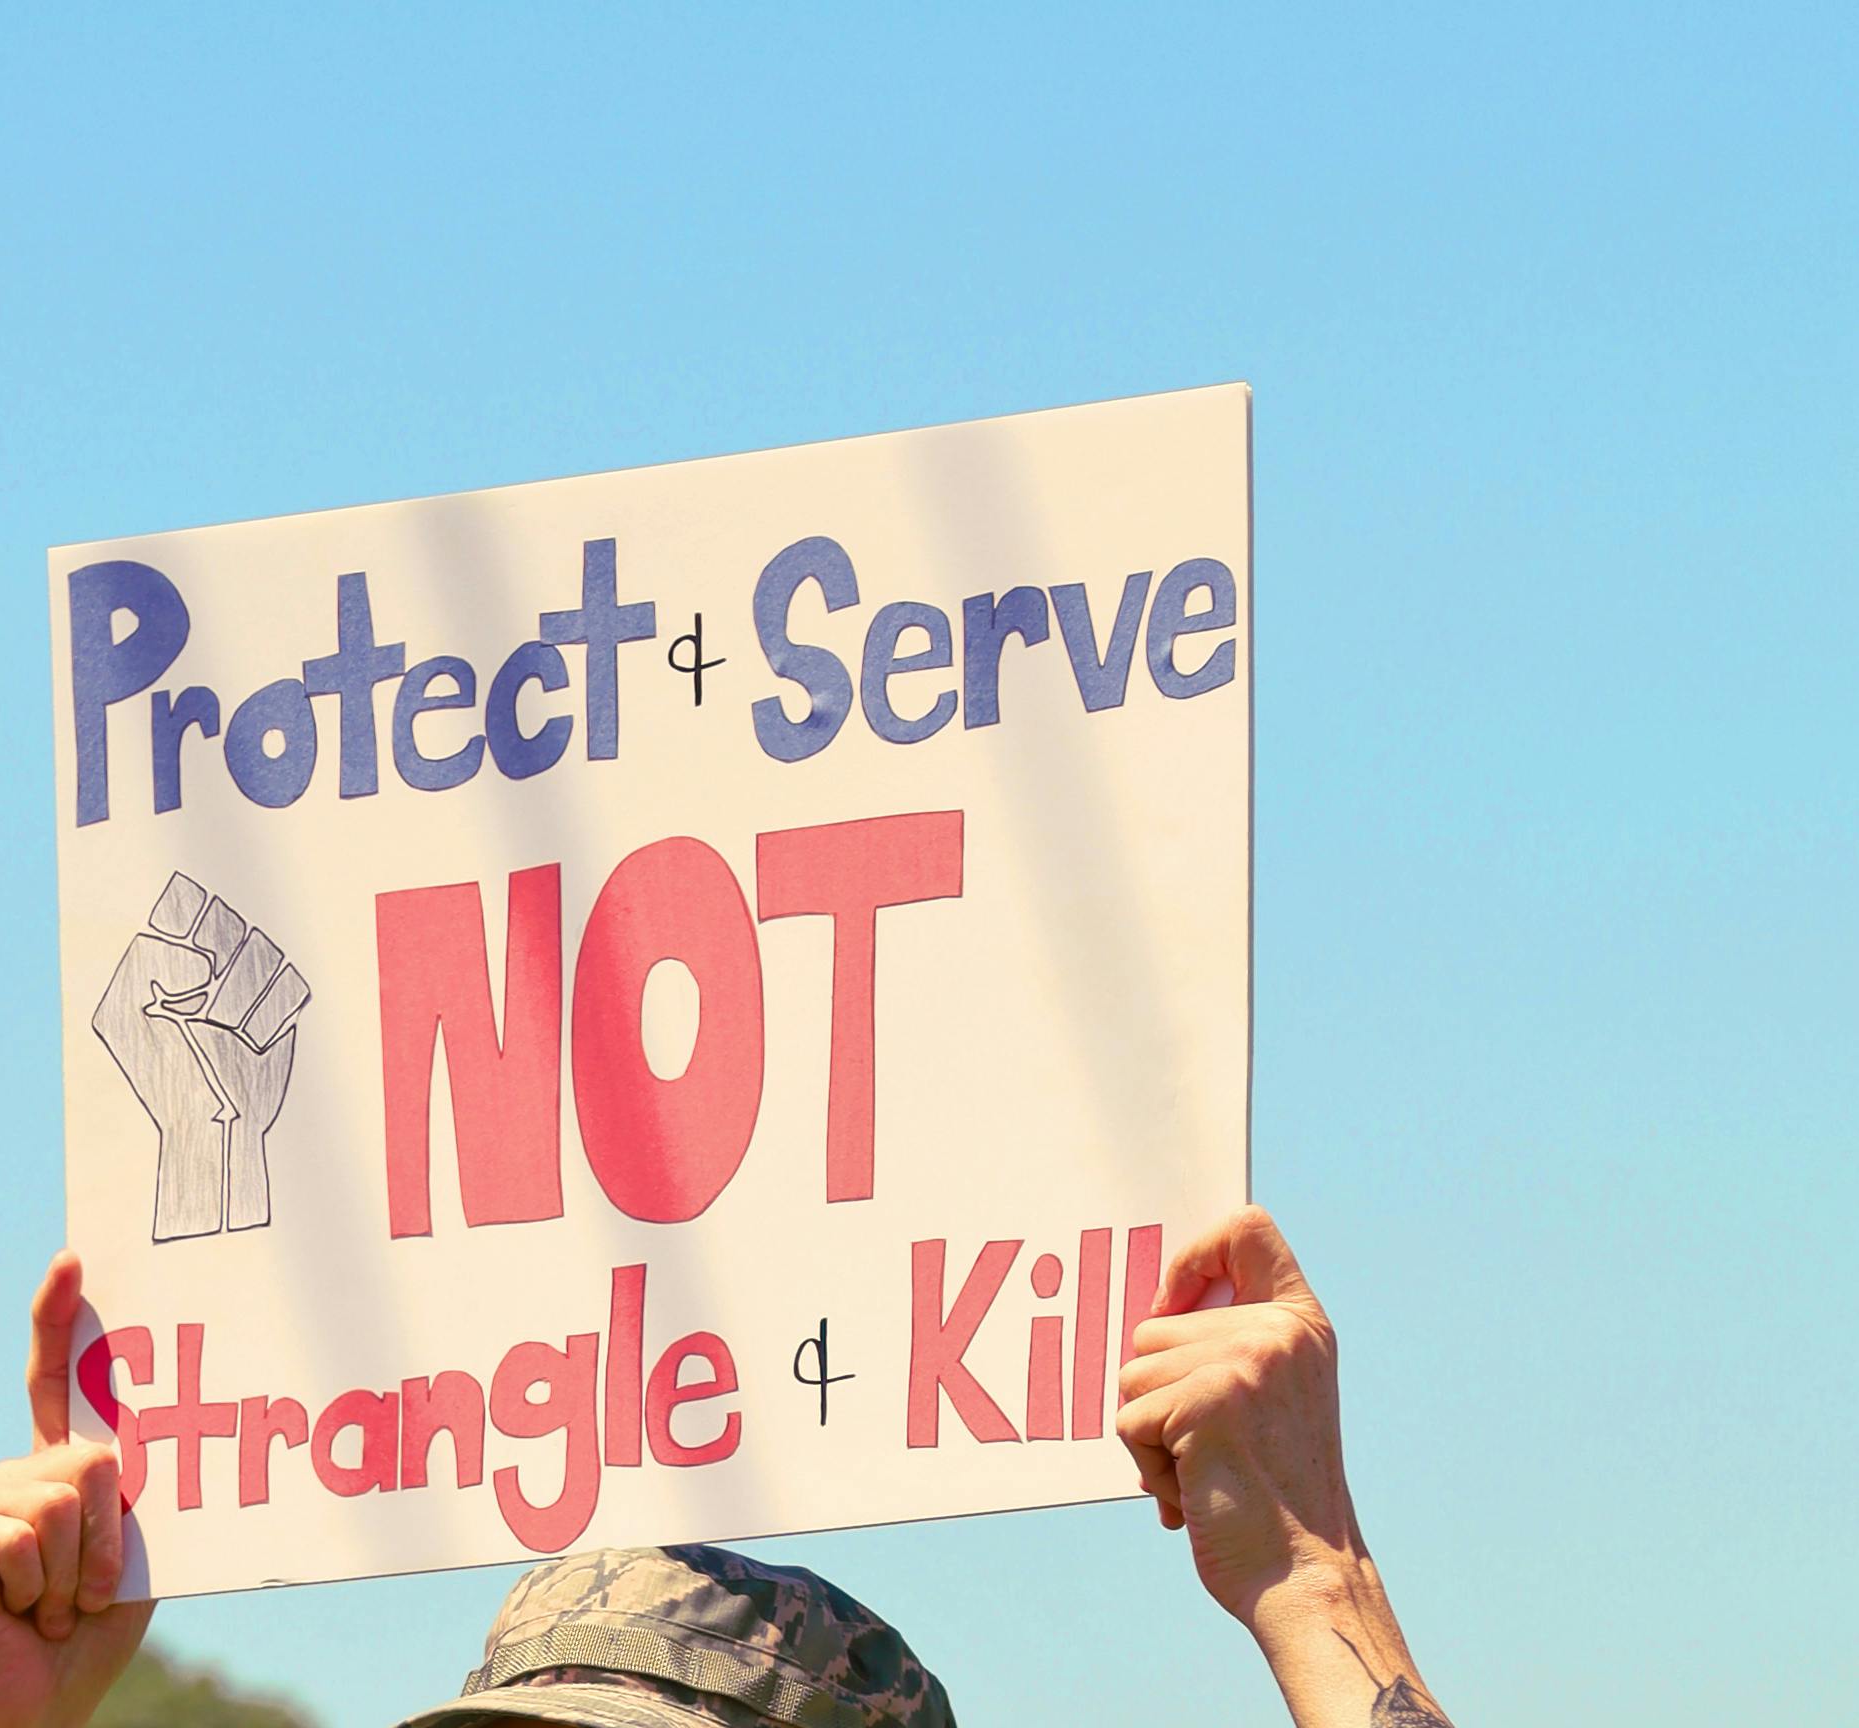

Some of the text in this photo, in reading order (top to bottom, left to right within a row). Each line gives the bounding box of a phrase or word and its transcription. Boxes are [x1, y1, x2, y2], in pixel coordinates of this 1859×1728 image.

[67, 537, 657, 828] Protect
[751, 535, 1239, 763] Serve
[374, 808, 966, 1239] NOT
[76, 1262, 742, 1554] Strangle
